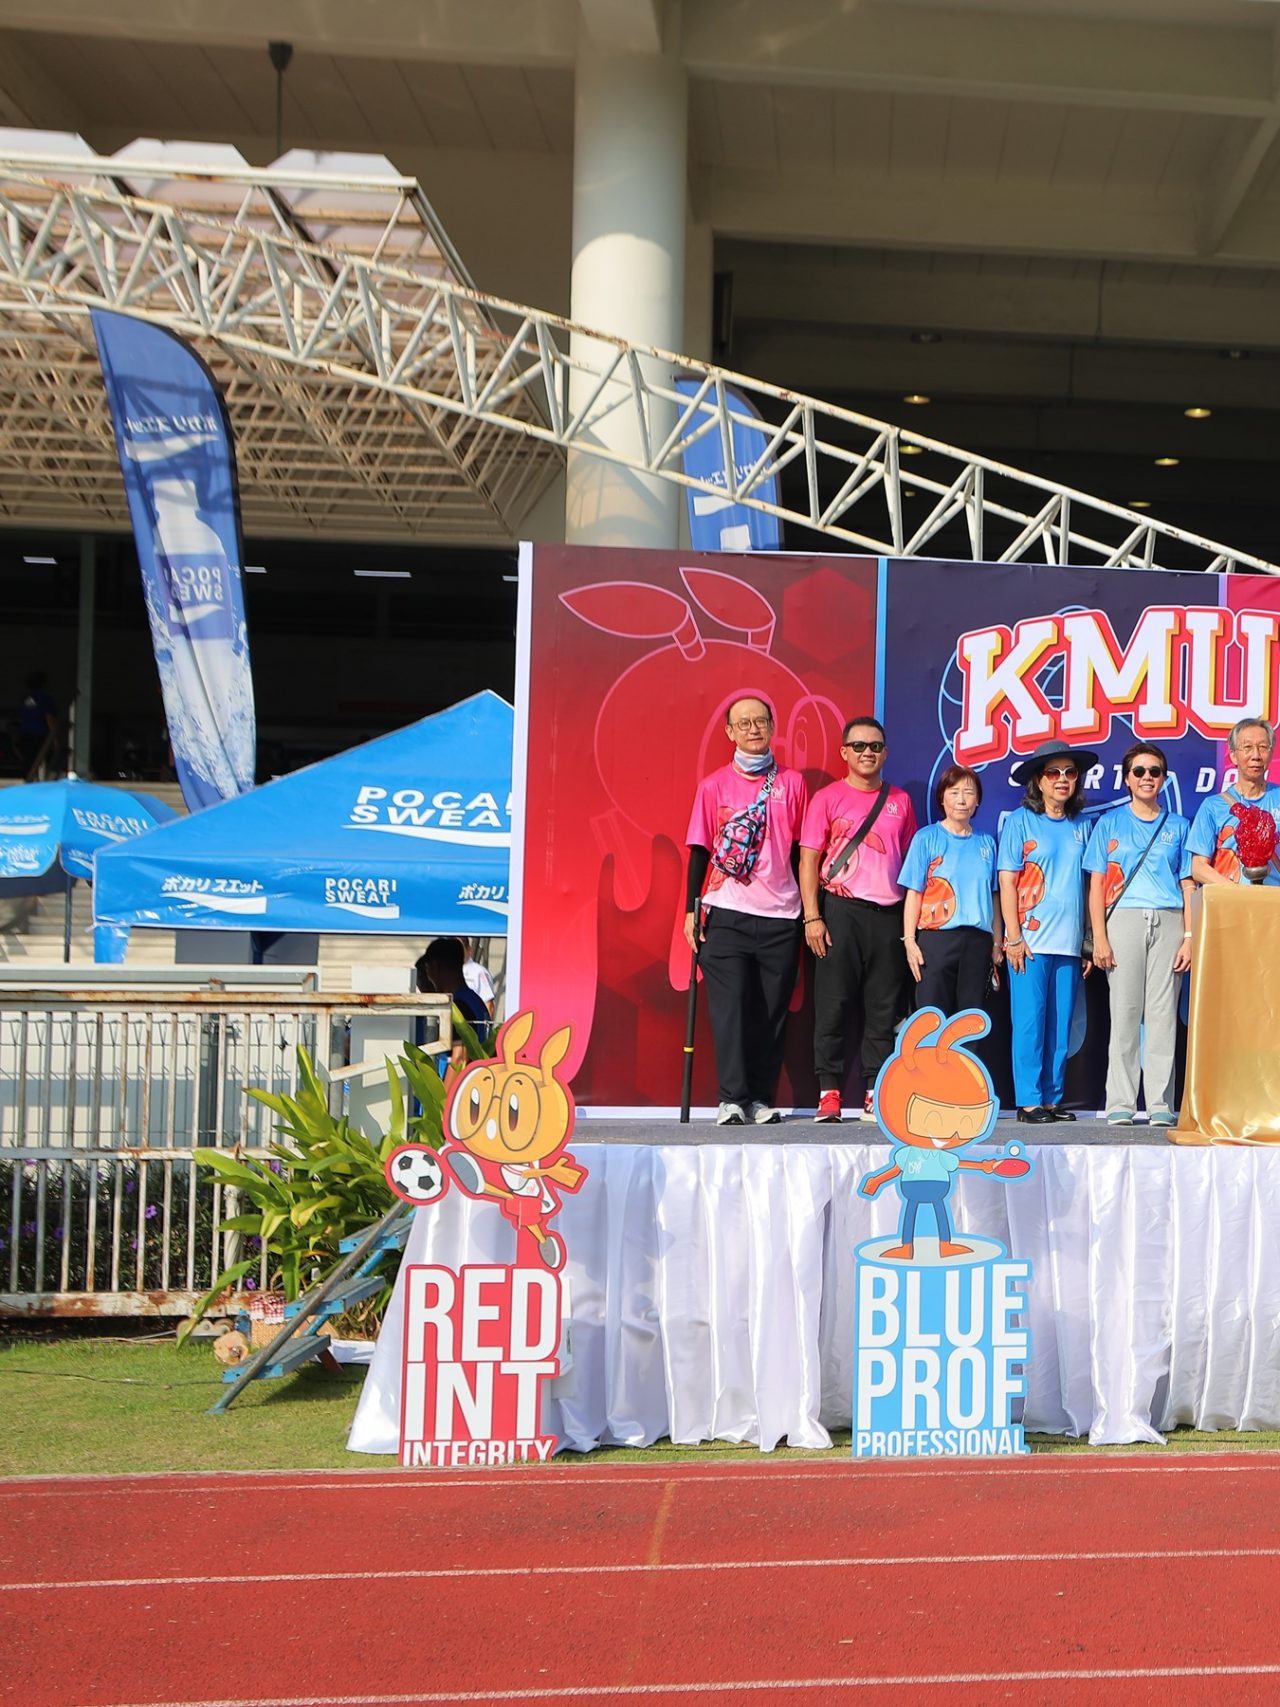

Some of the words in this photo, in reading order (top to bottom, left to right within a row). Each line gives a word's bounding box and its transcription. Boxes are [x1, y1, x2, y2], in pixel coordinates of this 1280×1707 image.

[1195, 767, 1269, 793] DA
[357, 786, 512, 812] POCA
[350, 805, 512, 827] SWEA
[325, 878, 397, 892] POCARI
[325, 890, 390, 904] SWEAT
[407, 1269, 558, 1362] RED
[859, 1264, 1028, 1348] BLUE
[404, 1362, 556, 1440] INT
[857, 1346, 1028, 1430] PROF
[403, 1440, 554, 1467] INTEGRITY
[857, 1429, 1026, 1457] PROFESSIONAL
